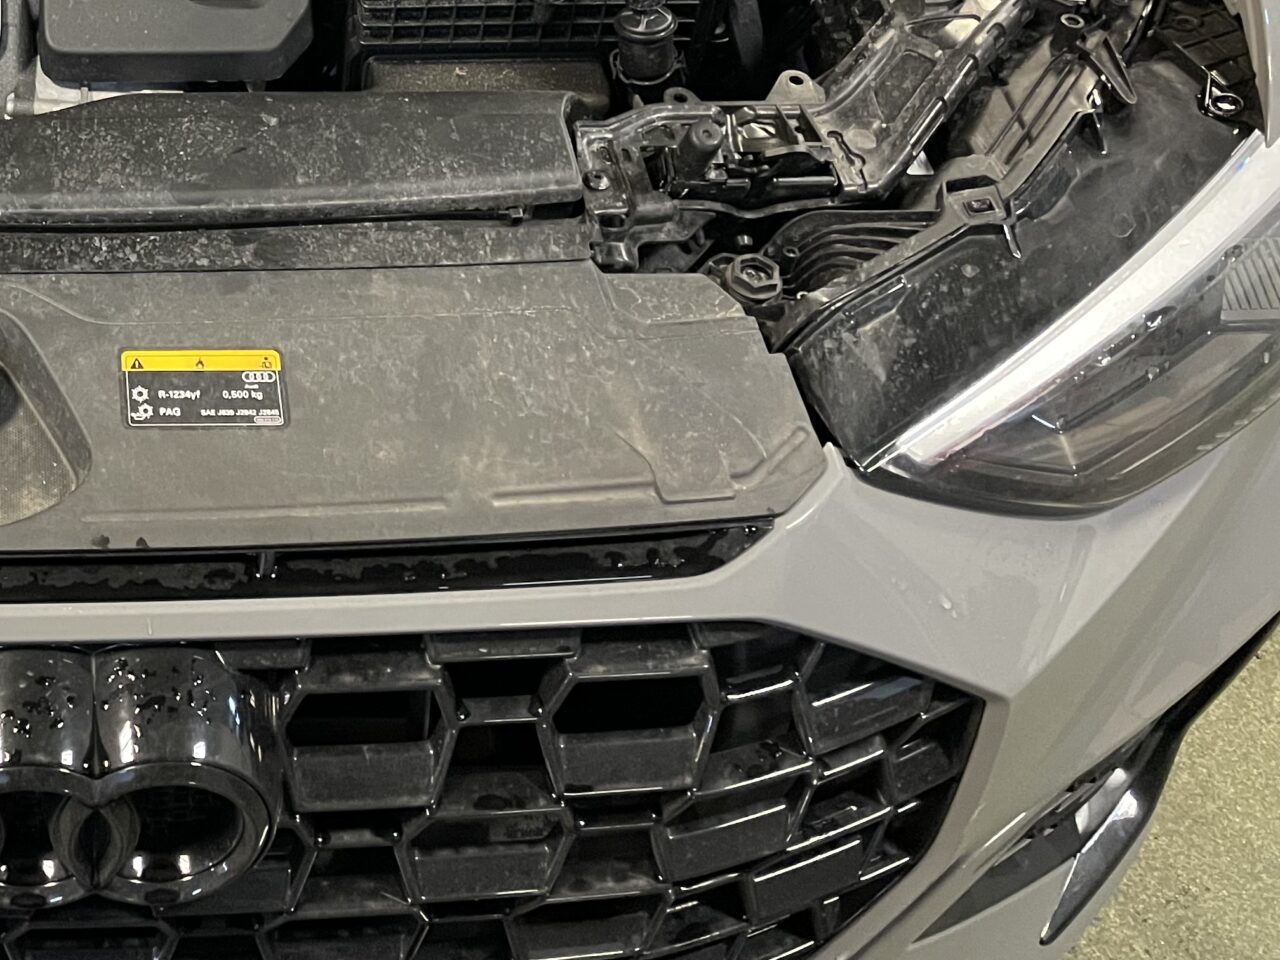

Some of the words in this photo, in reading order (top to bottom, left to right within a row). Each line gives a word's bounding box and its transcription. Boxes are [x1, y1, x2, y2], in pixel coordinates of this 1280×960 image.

[158, 390, 201, 401] R-1234yf
[251, 390, 263, 401] kg
[159, 407, 181, 417] PAG
